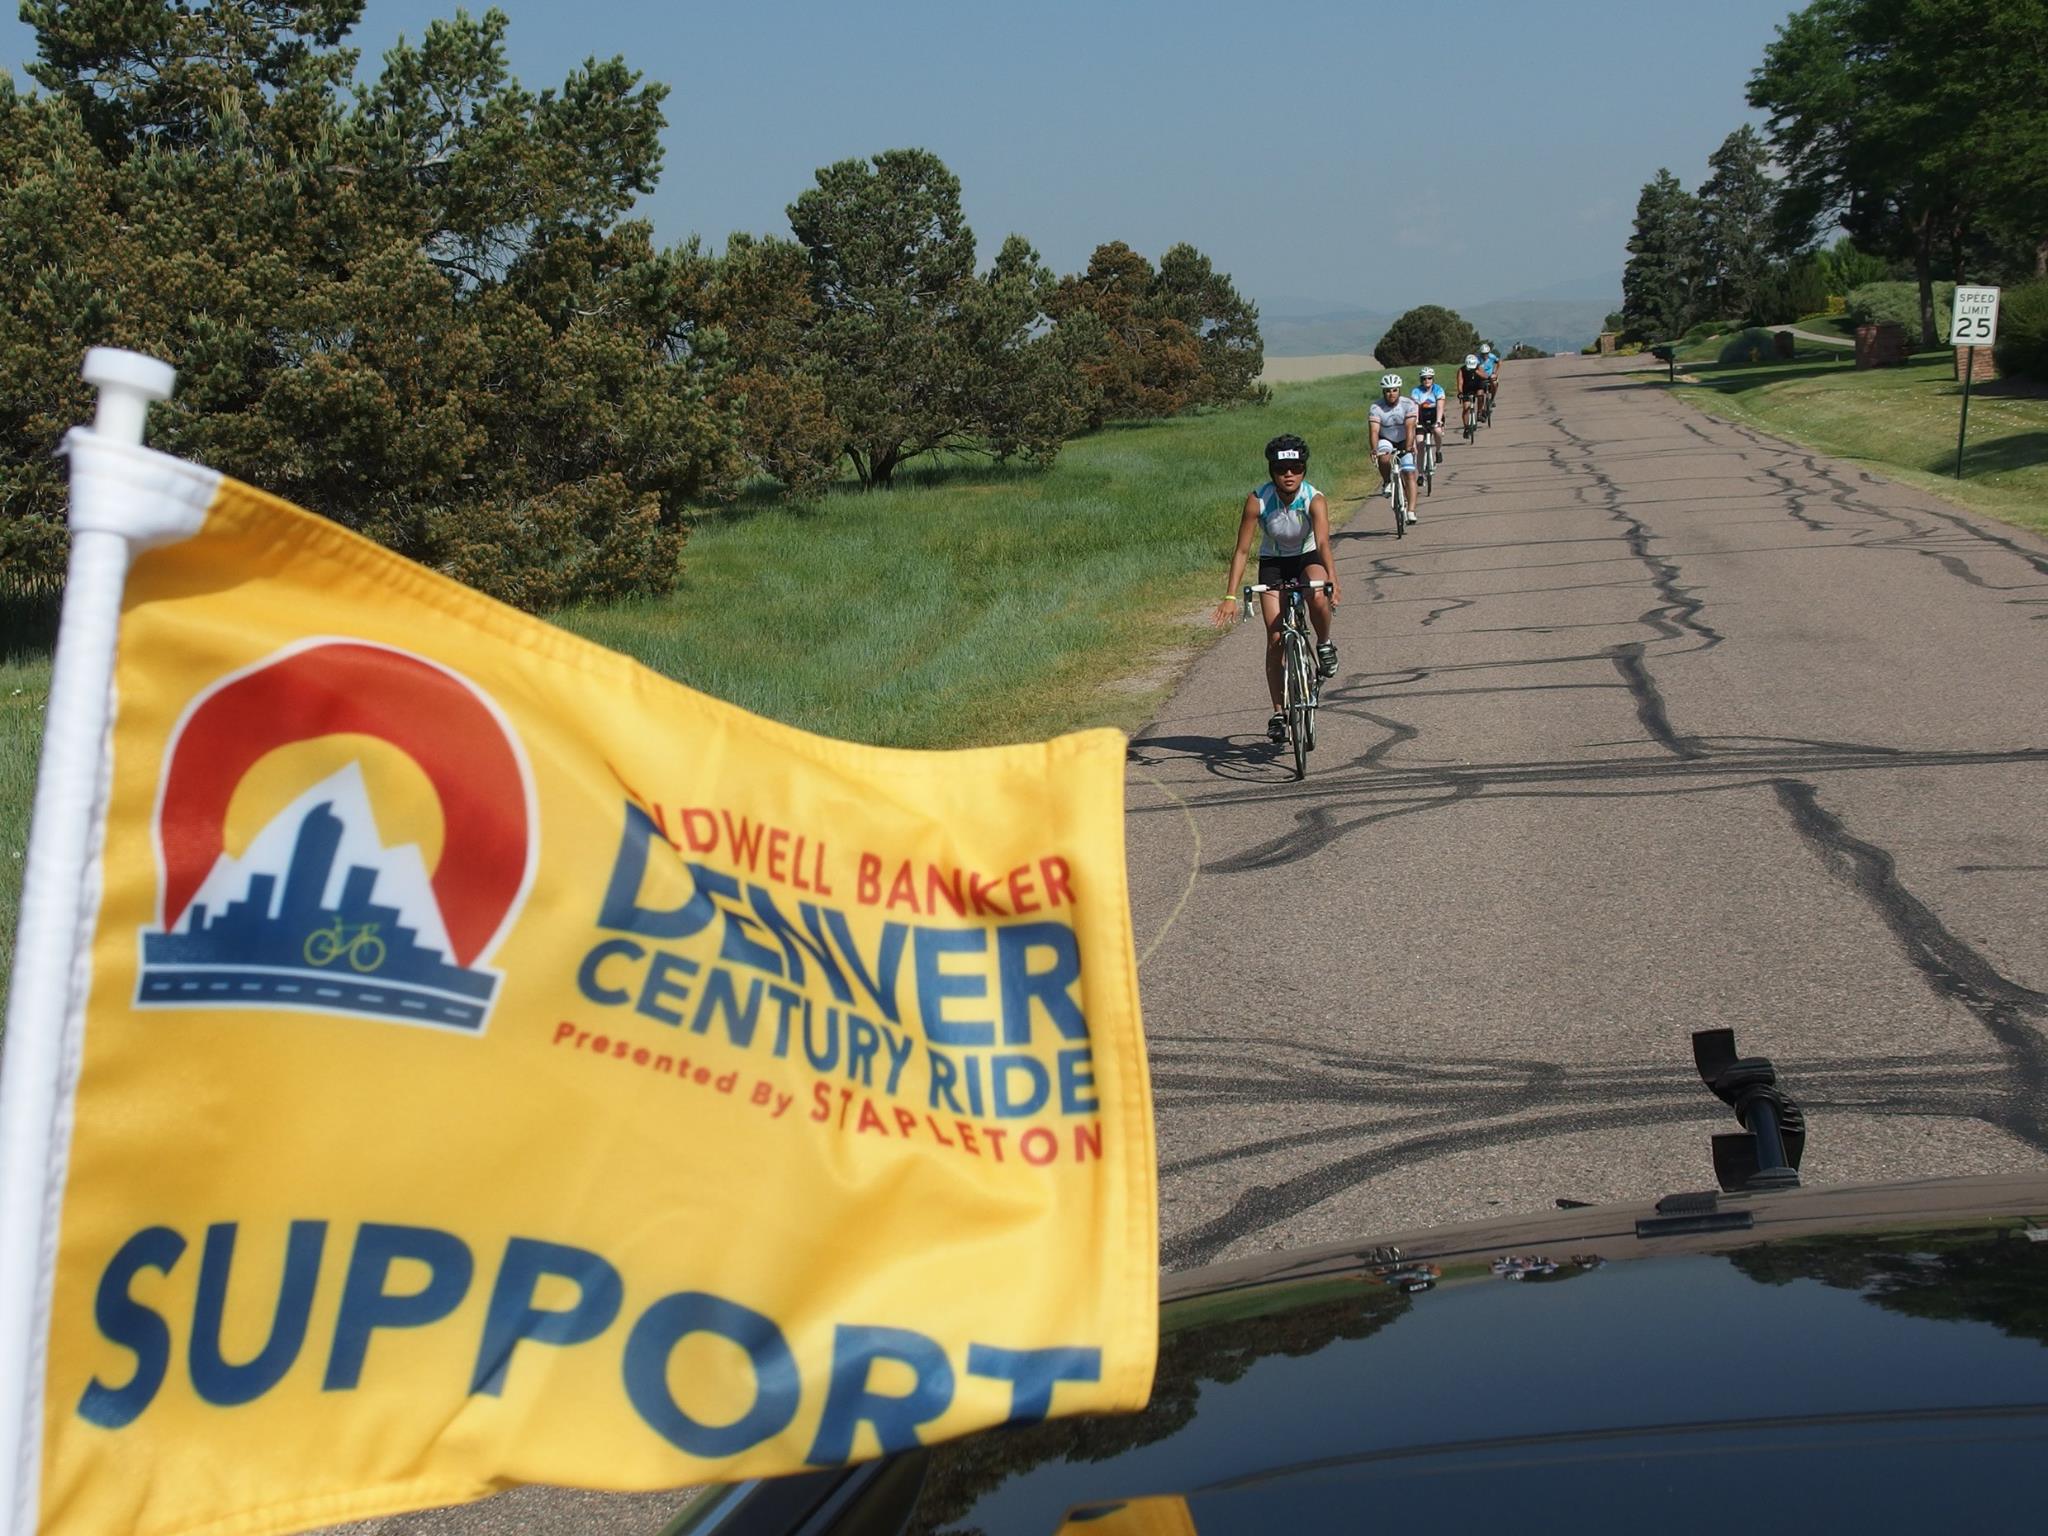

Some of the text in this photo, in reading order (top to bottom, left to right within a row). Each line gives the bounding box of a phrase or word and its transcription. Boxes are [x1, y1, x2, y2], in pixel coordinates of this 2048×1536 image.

[1956, 317, 1991, 338] 25
[1959, 293, 1995, 303] SPEED
[1961, 306, 1990, 315] LIMIT
[596, 798, 1093, 1048] DENVER
[652, 802, 1077, 918] LDWELL BANKER
[551, 1021, 1104, 1167] Presented By STAPLETON
[576, 938, 1100, 1119] CENTURY RIDE
[76, 1218, 1103, 1465] SUPPORT
